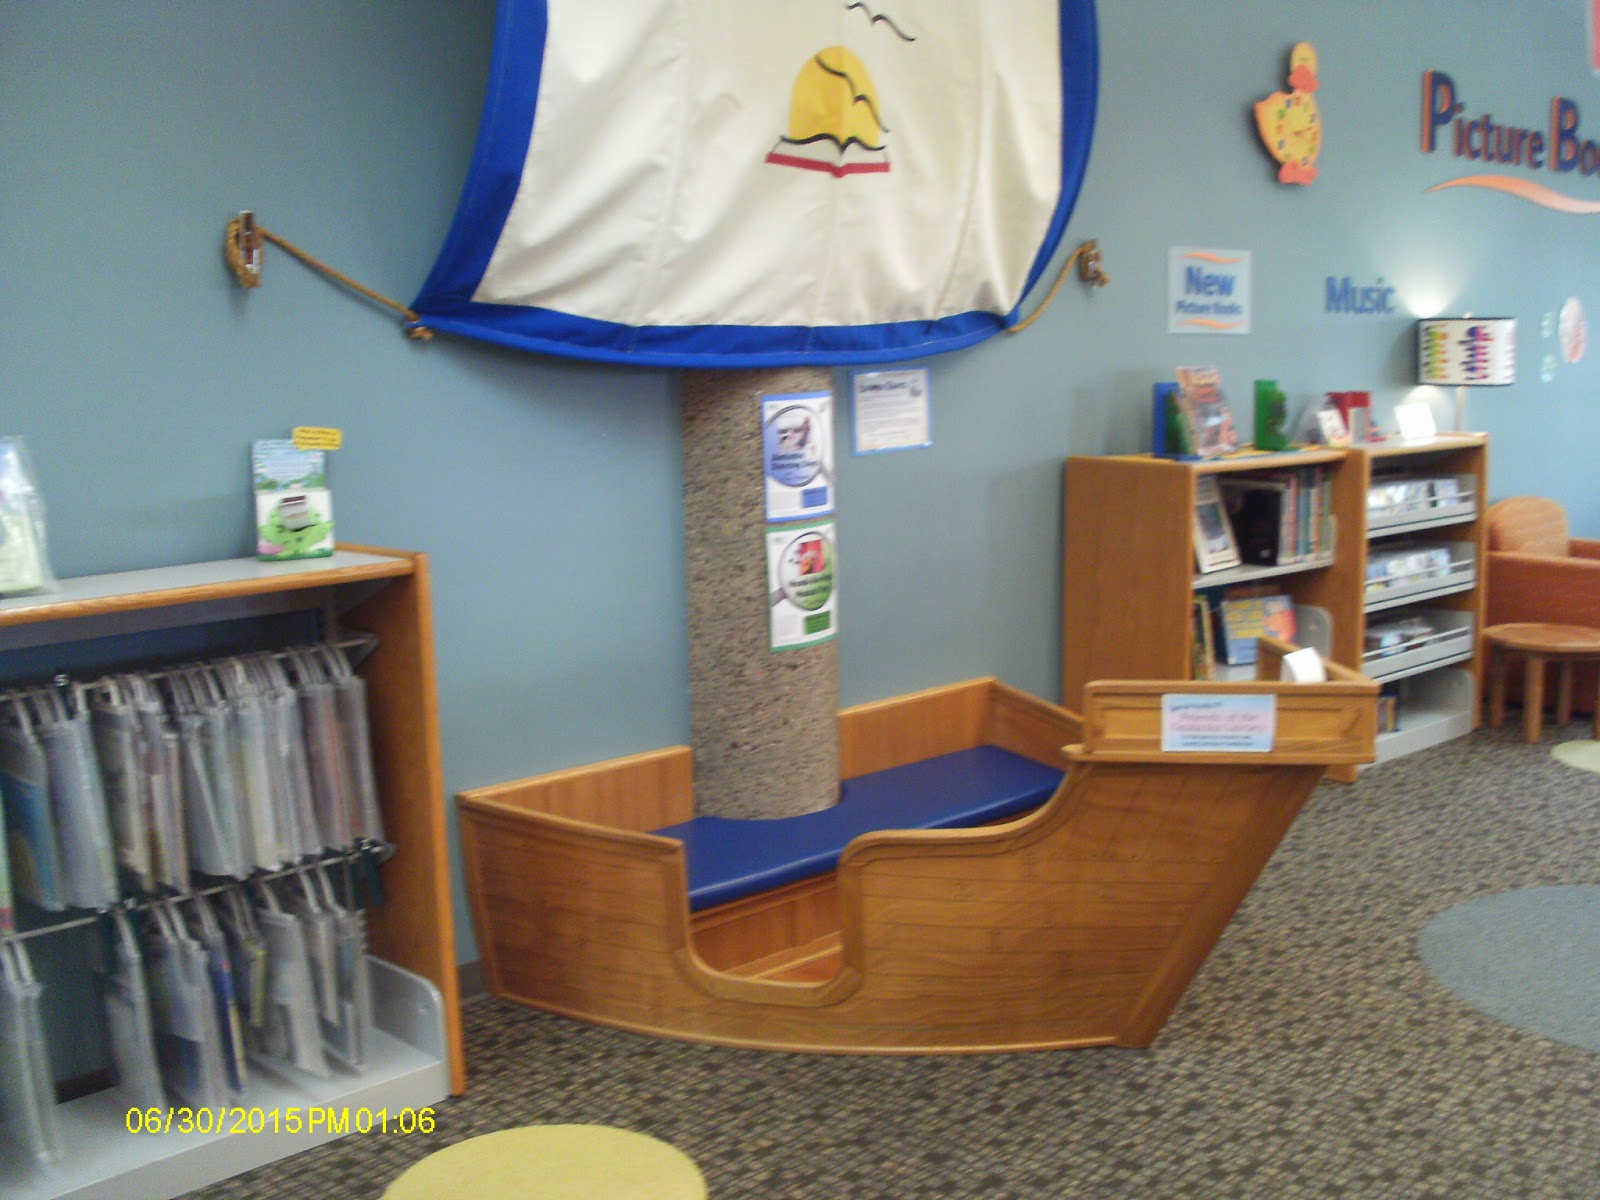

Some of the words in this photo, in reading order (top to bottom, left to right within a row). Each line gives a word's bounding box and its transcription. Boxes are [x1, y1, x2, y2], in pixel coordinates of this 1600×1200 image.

[1421, 69, 1543, 169] Picture
[1185, 265, 1236, 297] New
[1325, 275, 1395, 314] Music
